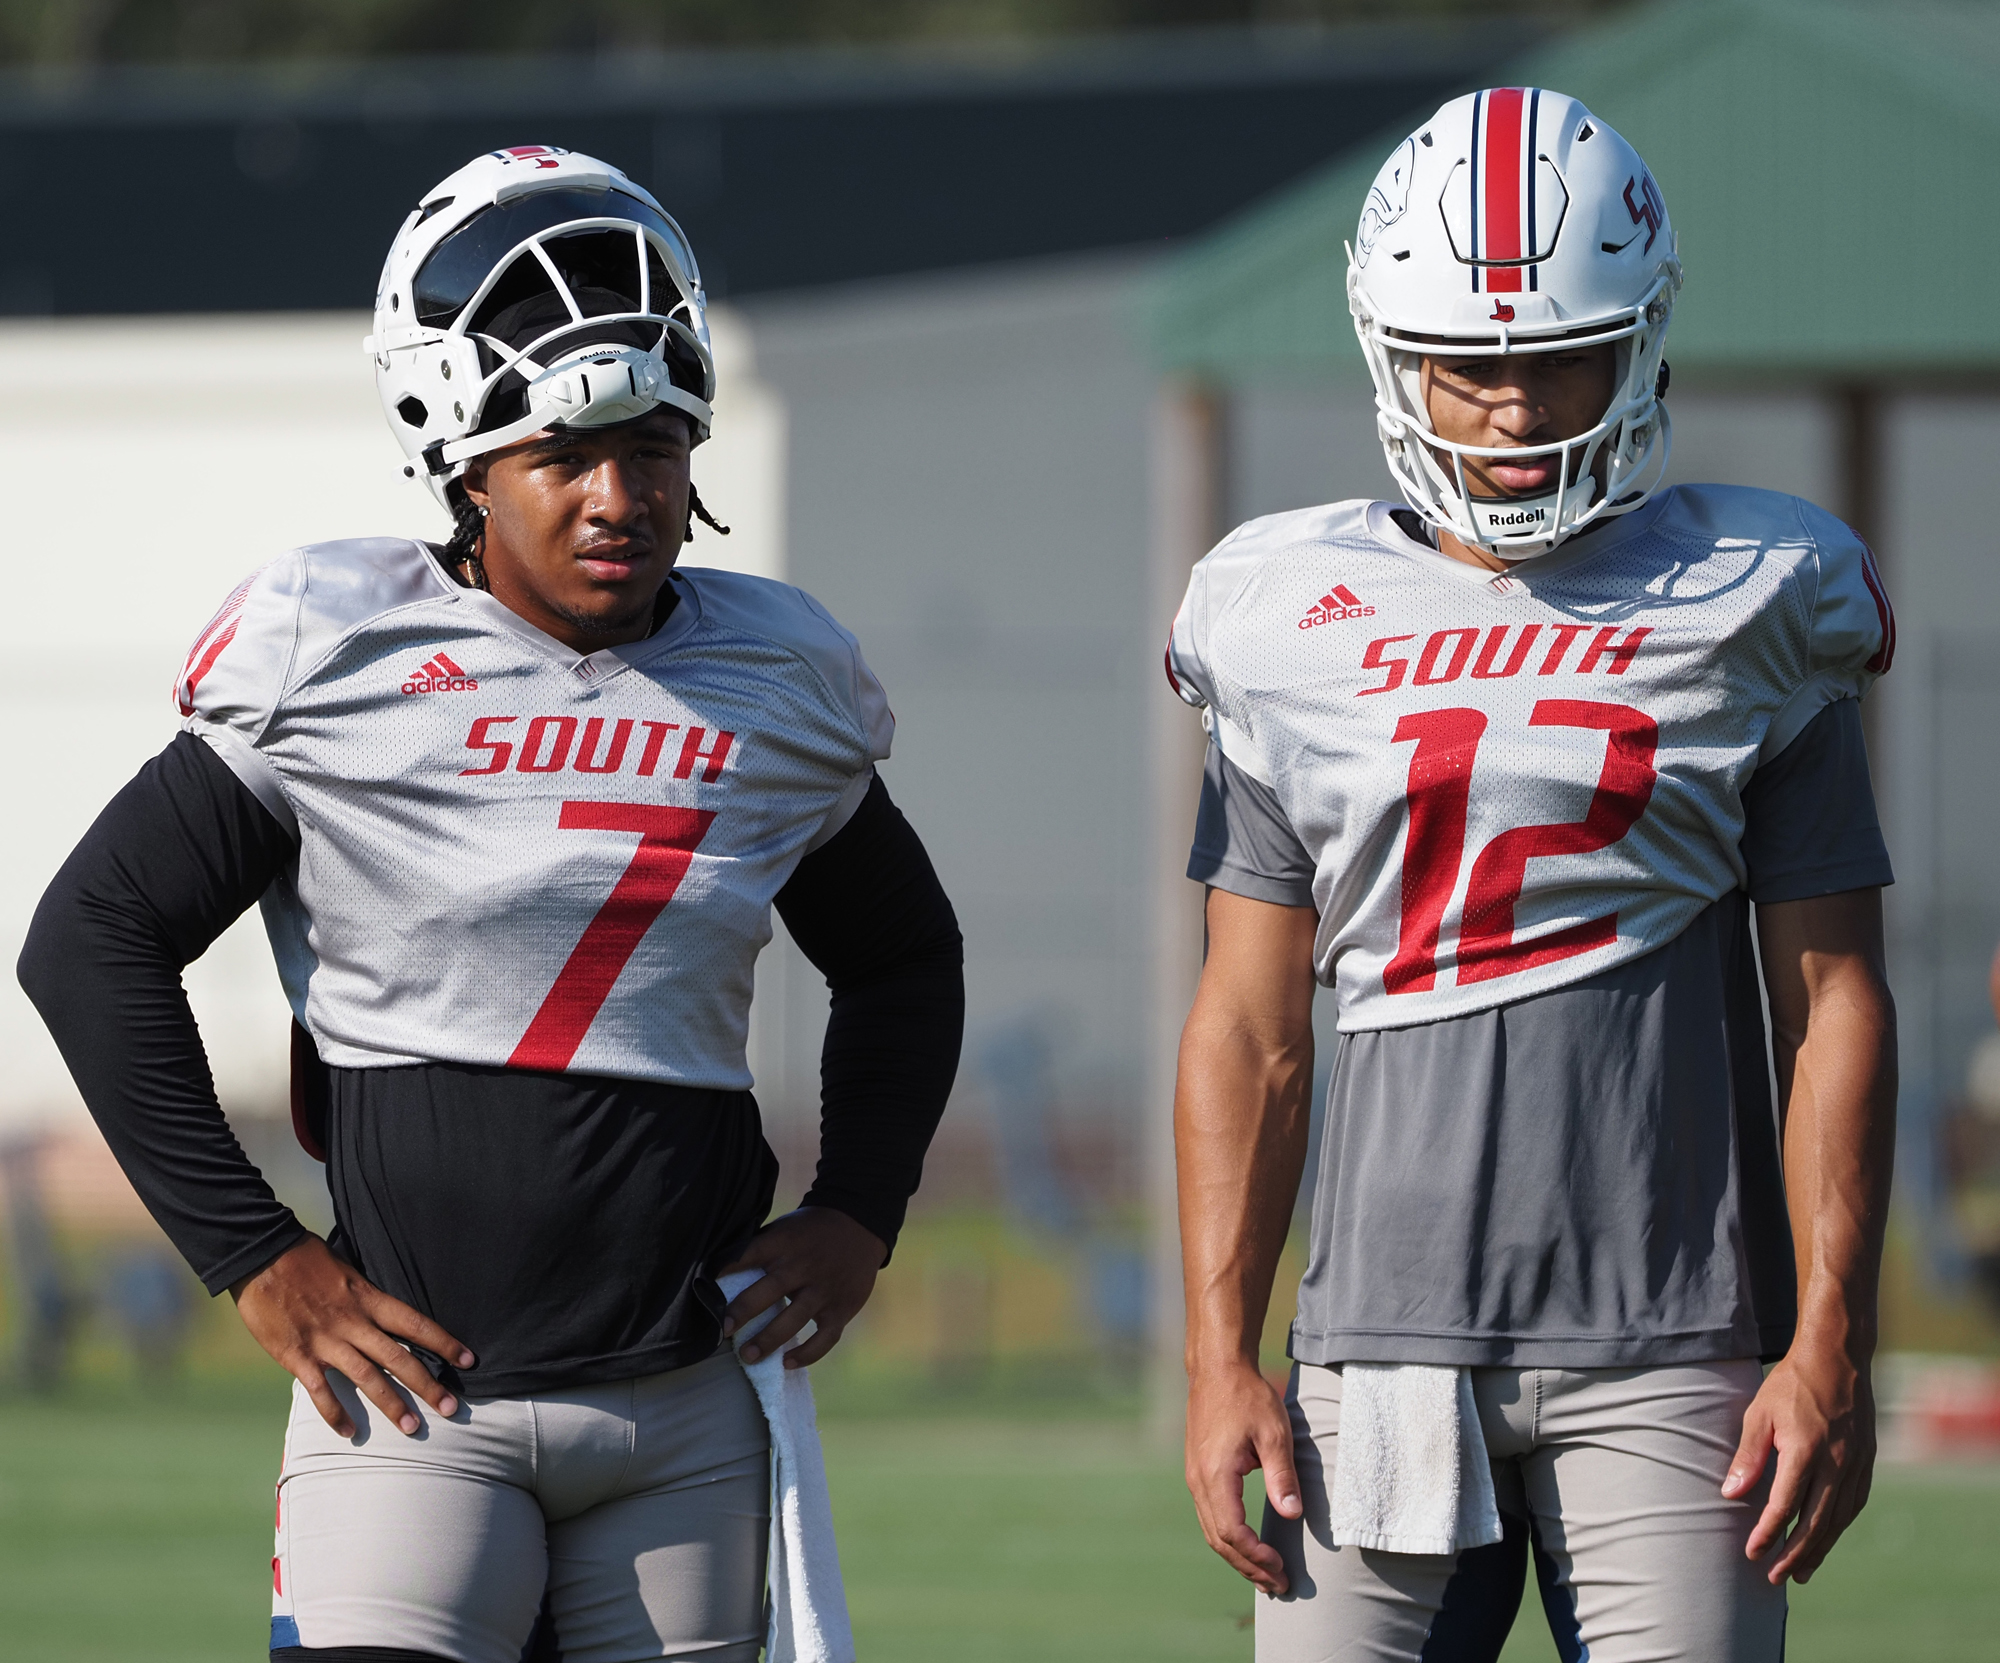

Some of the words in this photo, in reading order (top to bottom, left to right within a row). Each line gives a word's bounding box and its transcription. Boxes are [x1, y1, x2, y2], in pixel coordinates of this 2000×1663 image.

[579, 349, 621, 361] Riddell
[1489, 508, 1545, 526] Riddell
[1298, 605, 1376, 630] adidas
[1354, 623, 1655, 697] SOUTH
[401, 677, 478, 695] adidas
[457, 716, 736, 783] SOUTH
[1382, 699, 1659, 996] 12
[504, 801, 718, 1073] 7
